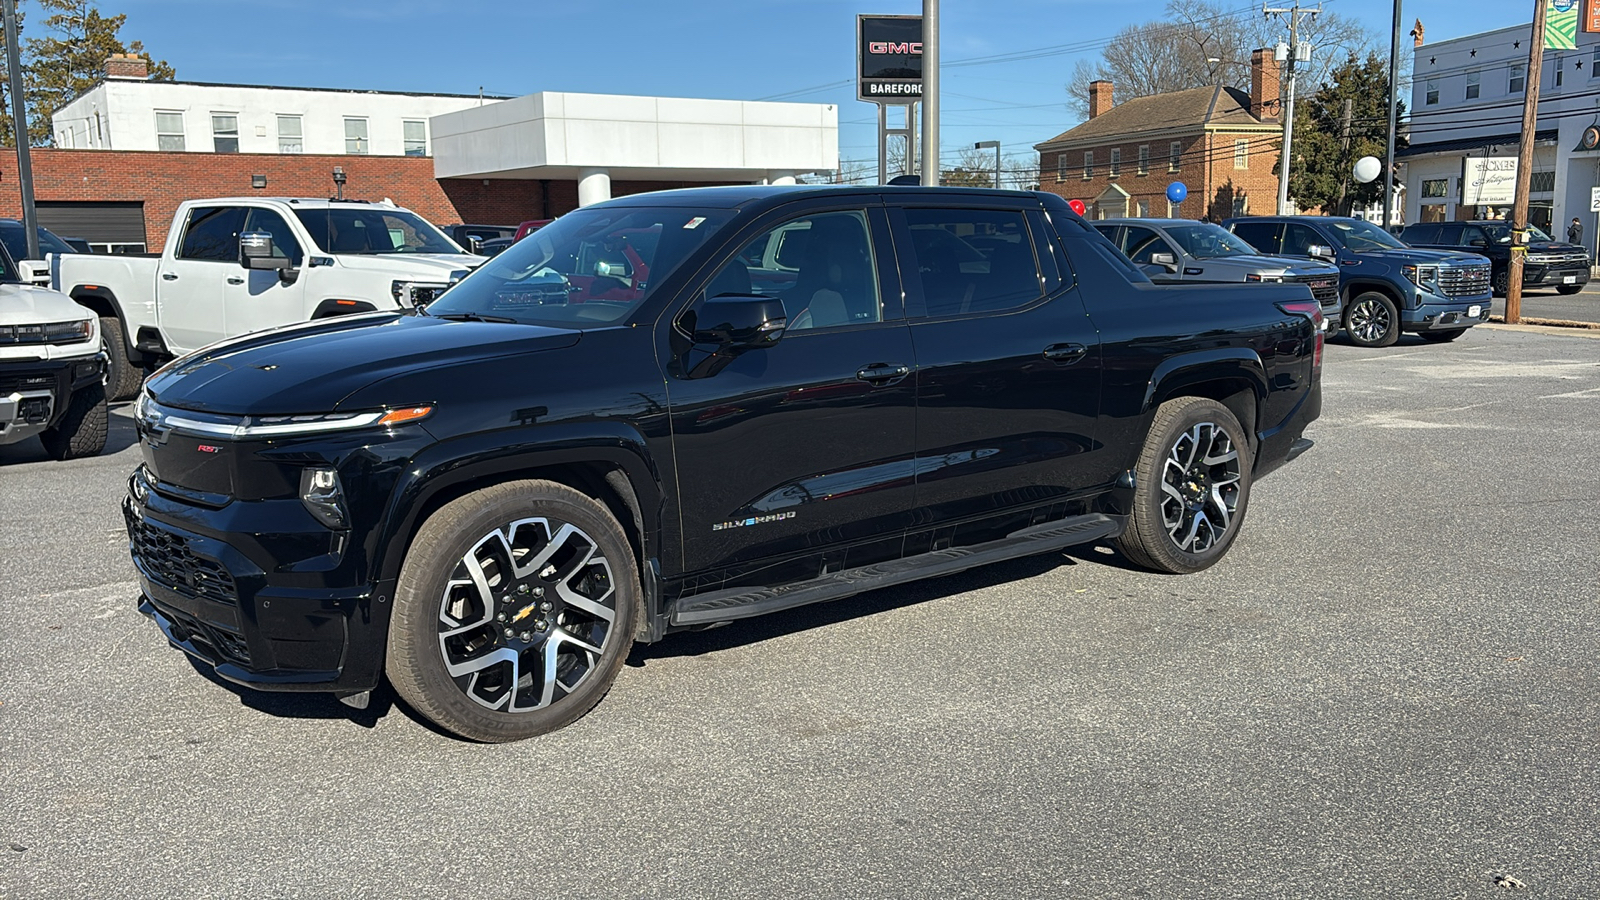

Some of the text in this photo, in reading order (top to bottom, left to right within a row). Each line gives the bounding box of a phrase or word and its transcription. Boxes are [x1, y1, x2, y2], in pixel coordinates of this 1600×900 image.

[869, 42, 923, 54] GMC
[198, 444, 223, 453] RST
[712, 511, 797, 531] SILVERADO
